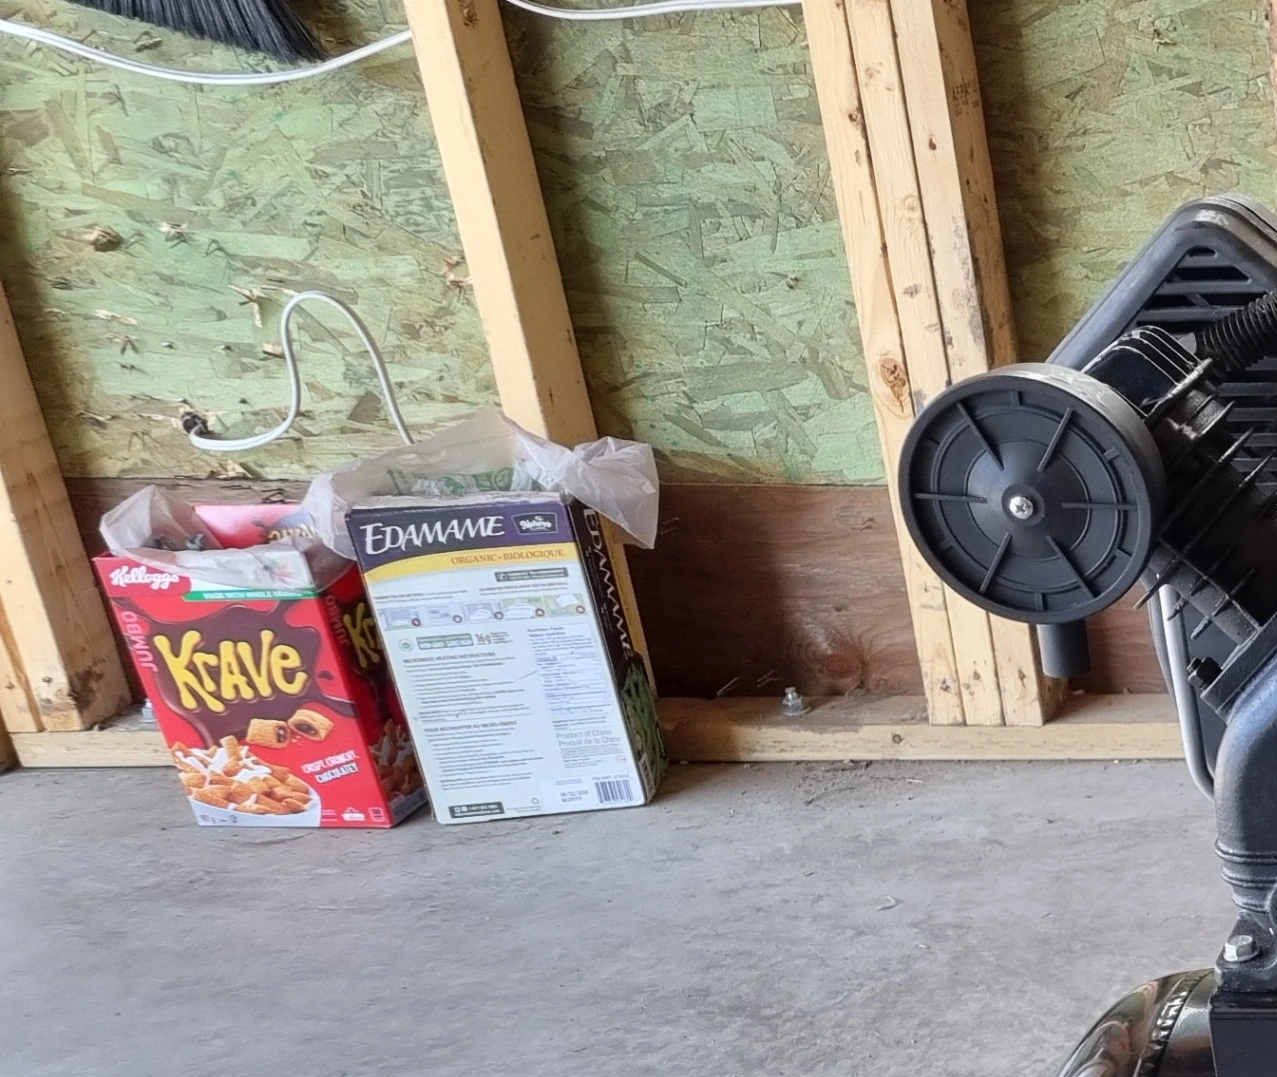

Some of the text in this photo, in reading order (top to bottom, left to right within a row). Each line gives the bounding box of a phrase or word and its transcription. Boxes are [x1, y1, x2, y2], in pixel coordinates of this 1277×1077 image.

[359, 515, 506, 556] EDAMAME
[451, 548, 565, 565] ORGANIC BIOLOGIQUE
[121, 610, 159, 673] JUMBO
